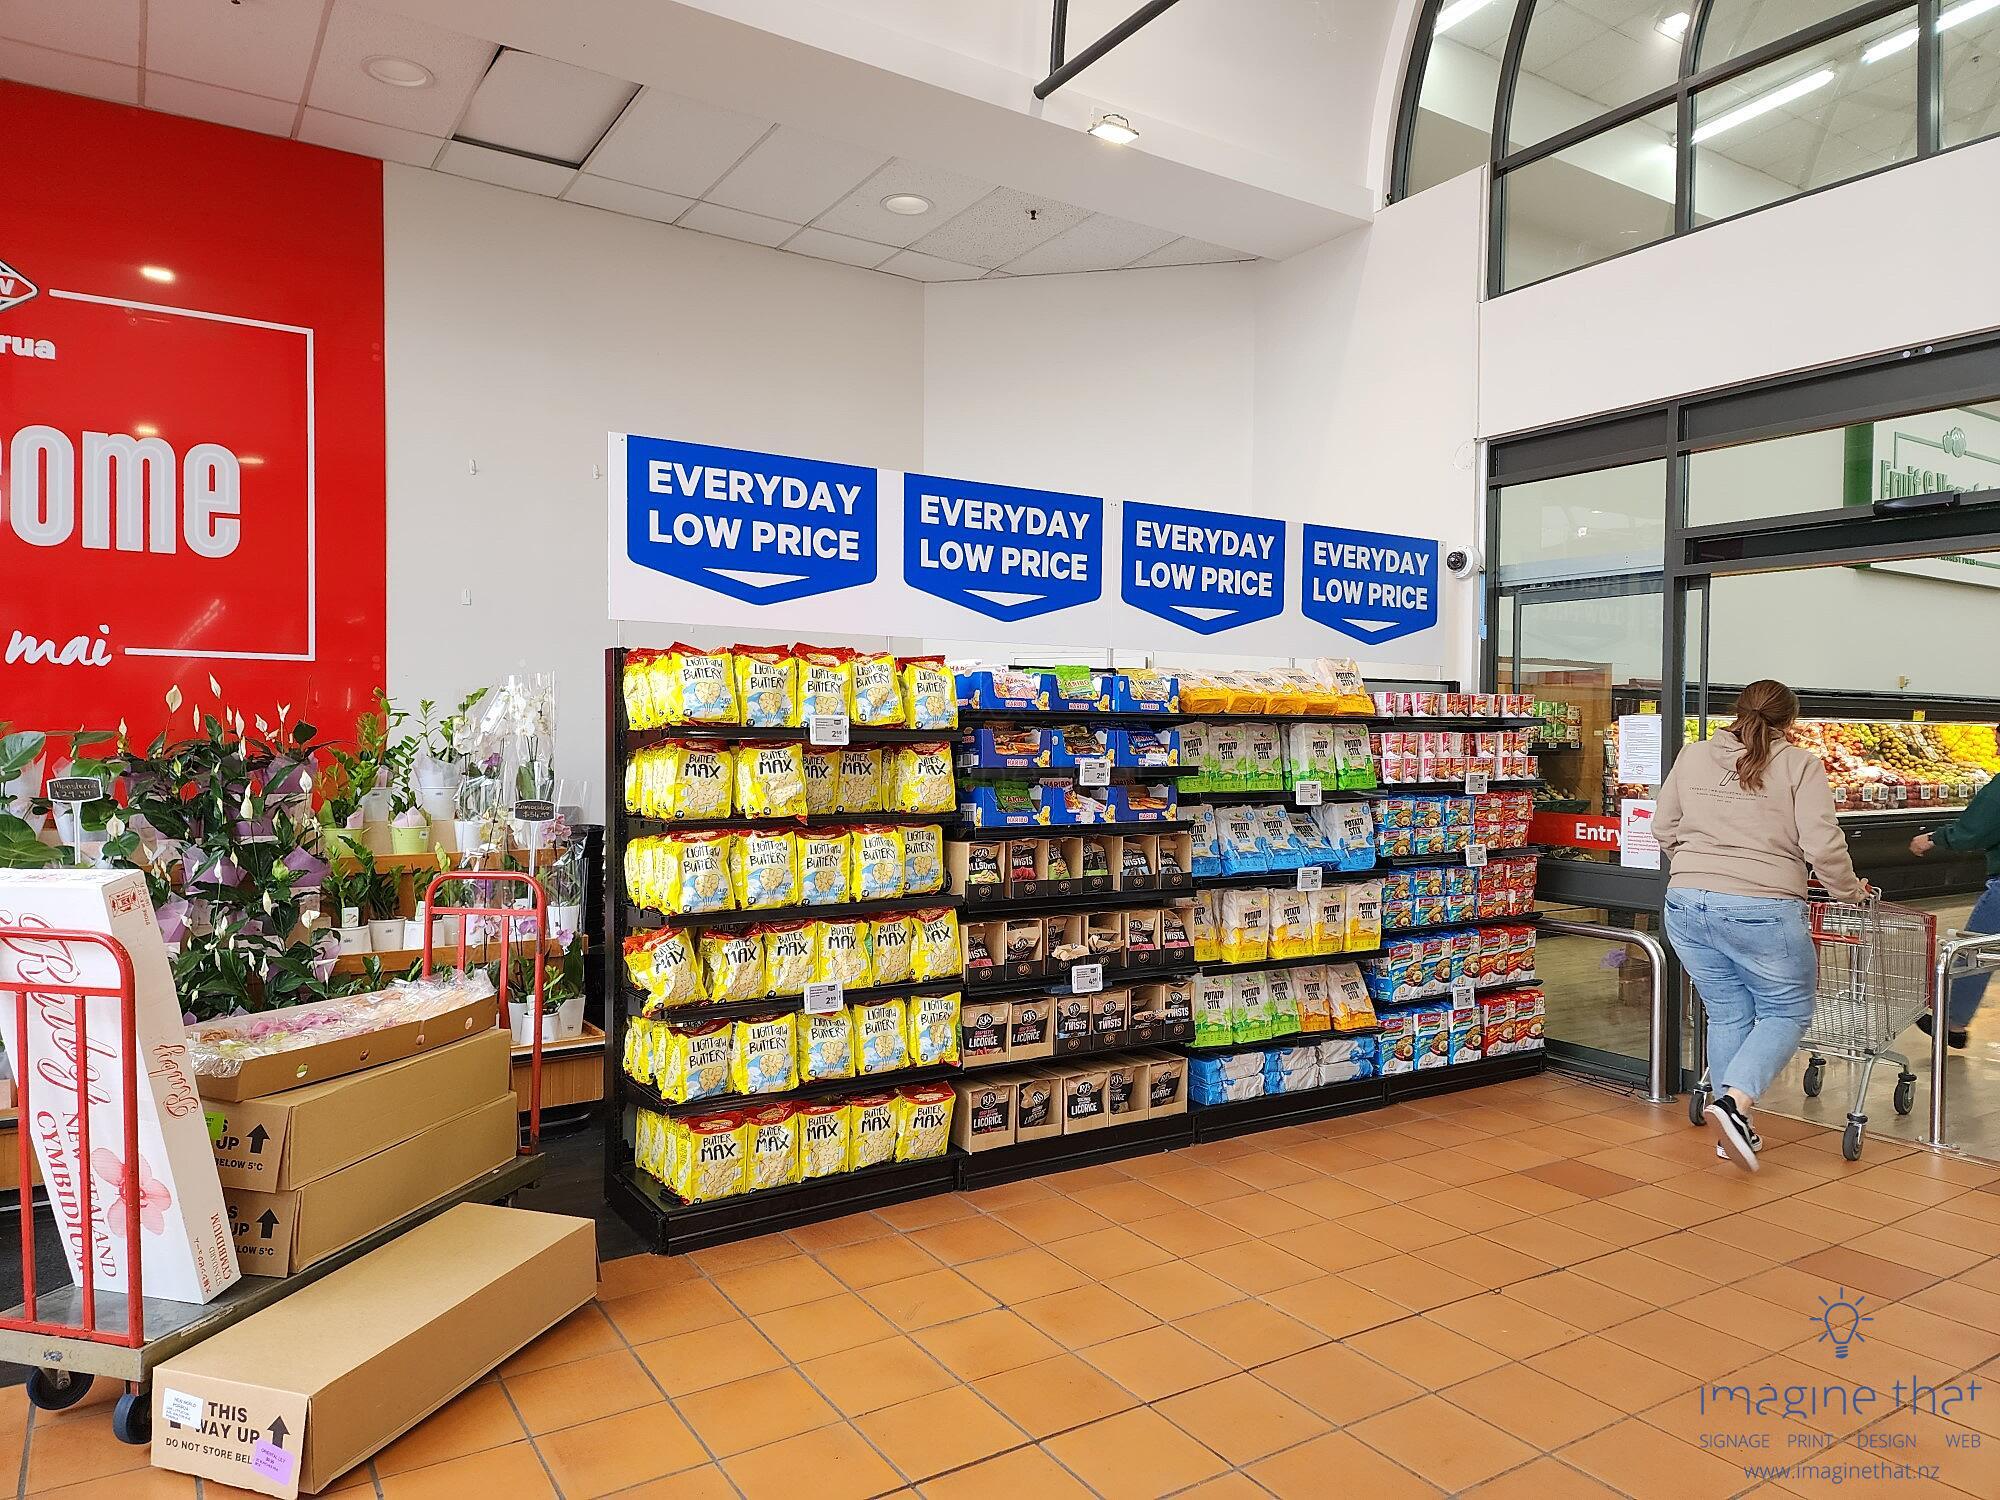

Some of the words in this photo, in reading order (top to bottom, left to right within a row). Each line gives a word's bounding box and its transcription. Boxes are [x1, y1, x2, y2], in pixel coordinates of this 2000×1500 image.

[0, 425, 241, 559] ome
[648, 459, 861, 515] EVERYDAY
[920, 494, 1090, 540] EVERYDAY
[648, 510, 742, 549] LOW
[752, 521, 860, 561] PRICE
[1136, 520, 1274, 559] EVERYDAY
[920, 539, 994, 572] LOW
[1001, 548, 1088, 581] PRICE
[1313, 541, 1429, 576] EVERYDAY
[1135, 561, 1195, 591] LOW
[1201, 567, 1273, 597] PRICE
[1313, 578, 1363, 605] LOW
[1368, 583, 1428, 610] PRICE
[4, 624, 112, 667] mai
[683, 668, 722, 680] BUTTERY
[751, 677, 785, 689] BUTTERY
[856, 674, 890, 687] BUTTERY
[808, 681, 841, 693] BUTTERY
[917, 683, 946, 693] BUTTERY
[1184, 738, 1202, 749] POTATO
[1219, 742, 1237, 751] POTATO
[1254, 742, 1272, 751] POTATO
[1313, 741, 1328, 749] POTATO
[1344, 739, 1362, 748] POTATO
[689, 754, 715, 763] BUTTER
[761, 750, 789, 760] BUTTER
[845, 753, 869, 762] BUTTER
[685, 764, 720, 779] MAX
[760, 759, 793, 774] MAX
[842, 762, 872, 775] MAX
[918, 763, 946, 775] MAX
[1231, 823, 1249, 832] POTATO
[1264, 821, 1282, 829] POTATO
[1345, 819, 1363, 828] POTATO
[864, 848, 895, 861] BUTTERY
[906, 843, 935, 854] BUTTERY
[750, 852, 786, 866] BUTTERY
[807, 857, 839, 869] BUTTERY
[684, 859, 718, 873] BUTTERY
[970, 862, 996, 871] LLSORTS
[1284, 906, 1300, 917] POTATO
[1324, 905, 1340, 913] POTATO
[1359, 903, 1377, 911] POTATO
[1245, 910, 1261, 920] POTATO
[831, 927, 855, 935] BUTTER
[880, 923, 903, 934] BUTTER
[777, 932, 805, 944] BUTTER
[829, 937, 856, 949] MAX
[878, 931, 907, 946] MAX
[777, 942, 808, 956] MAX
[725, 946, 757, 965] MAX
[1204, 991, 1224, 1000] POTATO
[1242, 988, 1260, 998] POTATO
[1207, 999, 1220, 1009] STIX
[1246, 997, 1258, 1007] STIX
[921, 1011, 950, 1025] BUTTERY
[1099, 1018, 1121, 1029] TWISTS
[865, 1019, 895, 1035] BUTTERY
[1065, 1021, 1087, 1031] TWISTS
[812, 1028, 846, 1040] BUTTERY
[1013, 1031, 1040, 1042] LICORICE
[750, 1037, 786, 1054] BUTTERY
[969, 1036, 998, 1047] LICORICE
[690, 1050, 726, 1068] BUTTERY
[864, 1106, 889, 1119] BUTTER
[917, 1105, 943, 1115] BUTTER
[1071, 1102, 1097, 1115] LICORICE
[809, 1115, 835, 1127] BUTTER
[862, 1115, 891, 1133] MAX
[913, 1113, 945, 1128] MAX
[974, 1115, 1002, 1128] LICORICE
[759, 1126, 783, 1139] BUTTER
[807, 1123, 838, 1141] MAX
[703, 1134, 732, 1147] BUTTER
[756, 1134, 789, 1153] MAX
[702, 1143, 736, 1162] MAX
[37, 1110, 85, 1272] CYMBIDIUM
[210, 1212, 231, 1280] CYMBIDIUM
[236, 1247, 256, 1255] LOW
[208, 1402, 248, 1422] THIS
[238, 1426, 260, 1444] UP
[166, 1438, 178, 1447] DO
[181, 1440, 200, 1452] NOT
[203, 1446, 232, 1459] STORE
[236, 1452, 252, 1464] BEL
